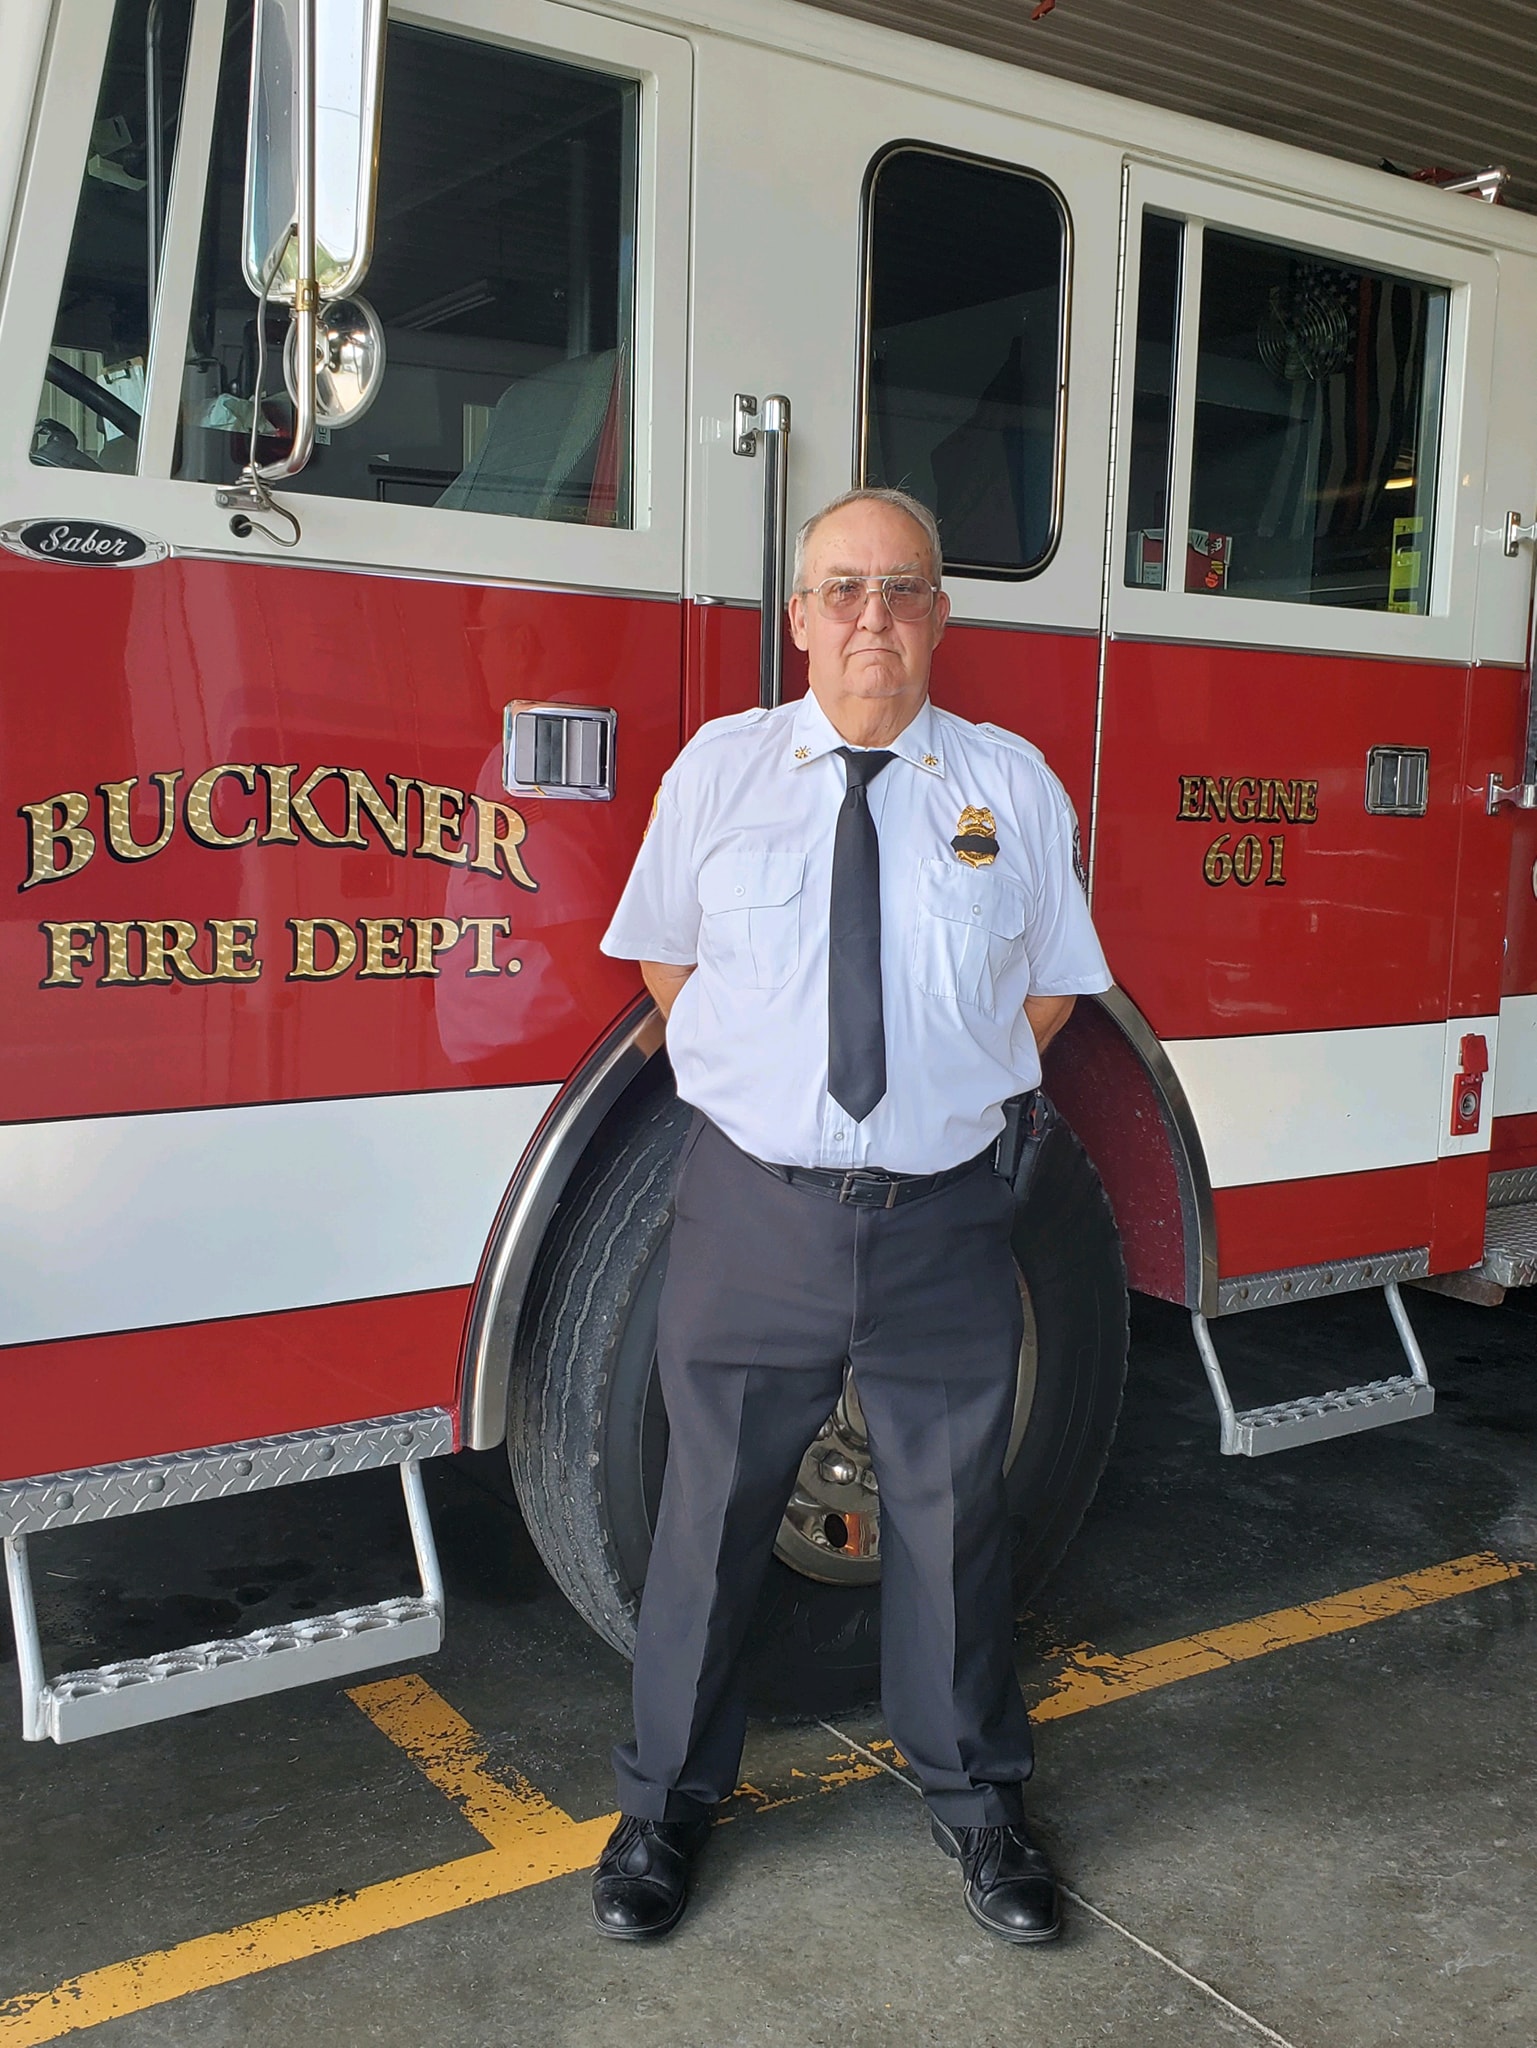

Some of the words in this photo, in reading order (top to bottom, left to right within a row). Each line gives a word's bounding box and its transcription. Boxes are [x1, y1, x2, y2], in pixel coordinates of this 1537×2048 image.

[40, 525, 128, 556] Saber
[1176, 775, 1319, 824] ENGINE
[18, 763, 538, 893] BUCKNER
[1203, 832, 1286, 887] 601
[38, 918, 262, 989] FIRE
[285, 915, 524, 983] DEPT.
